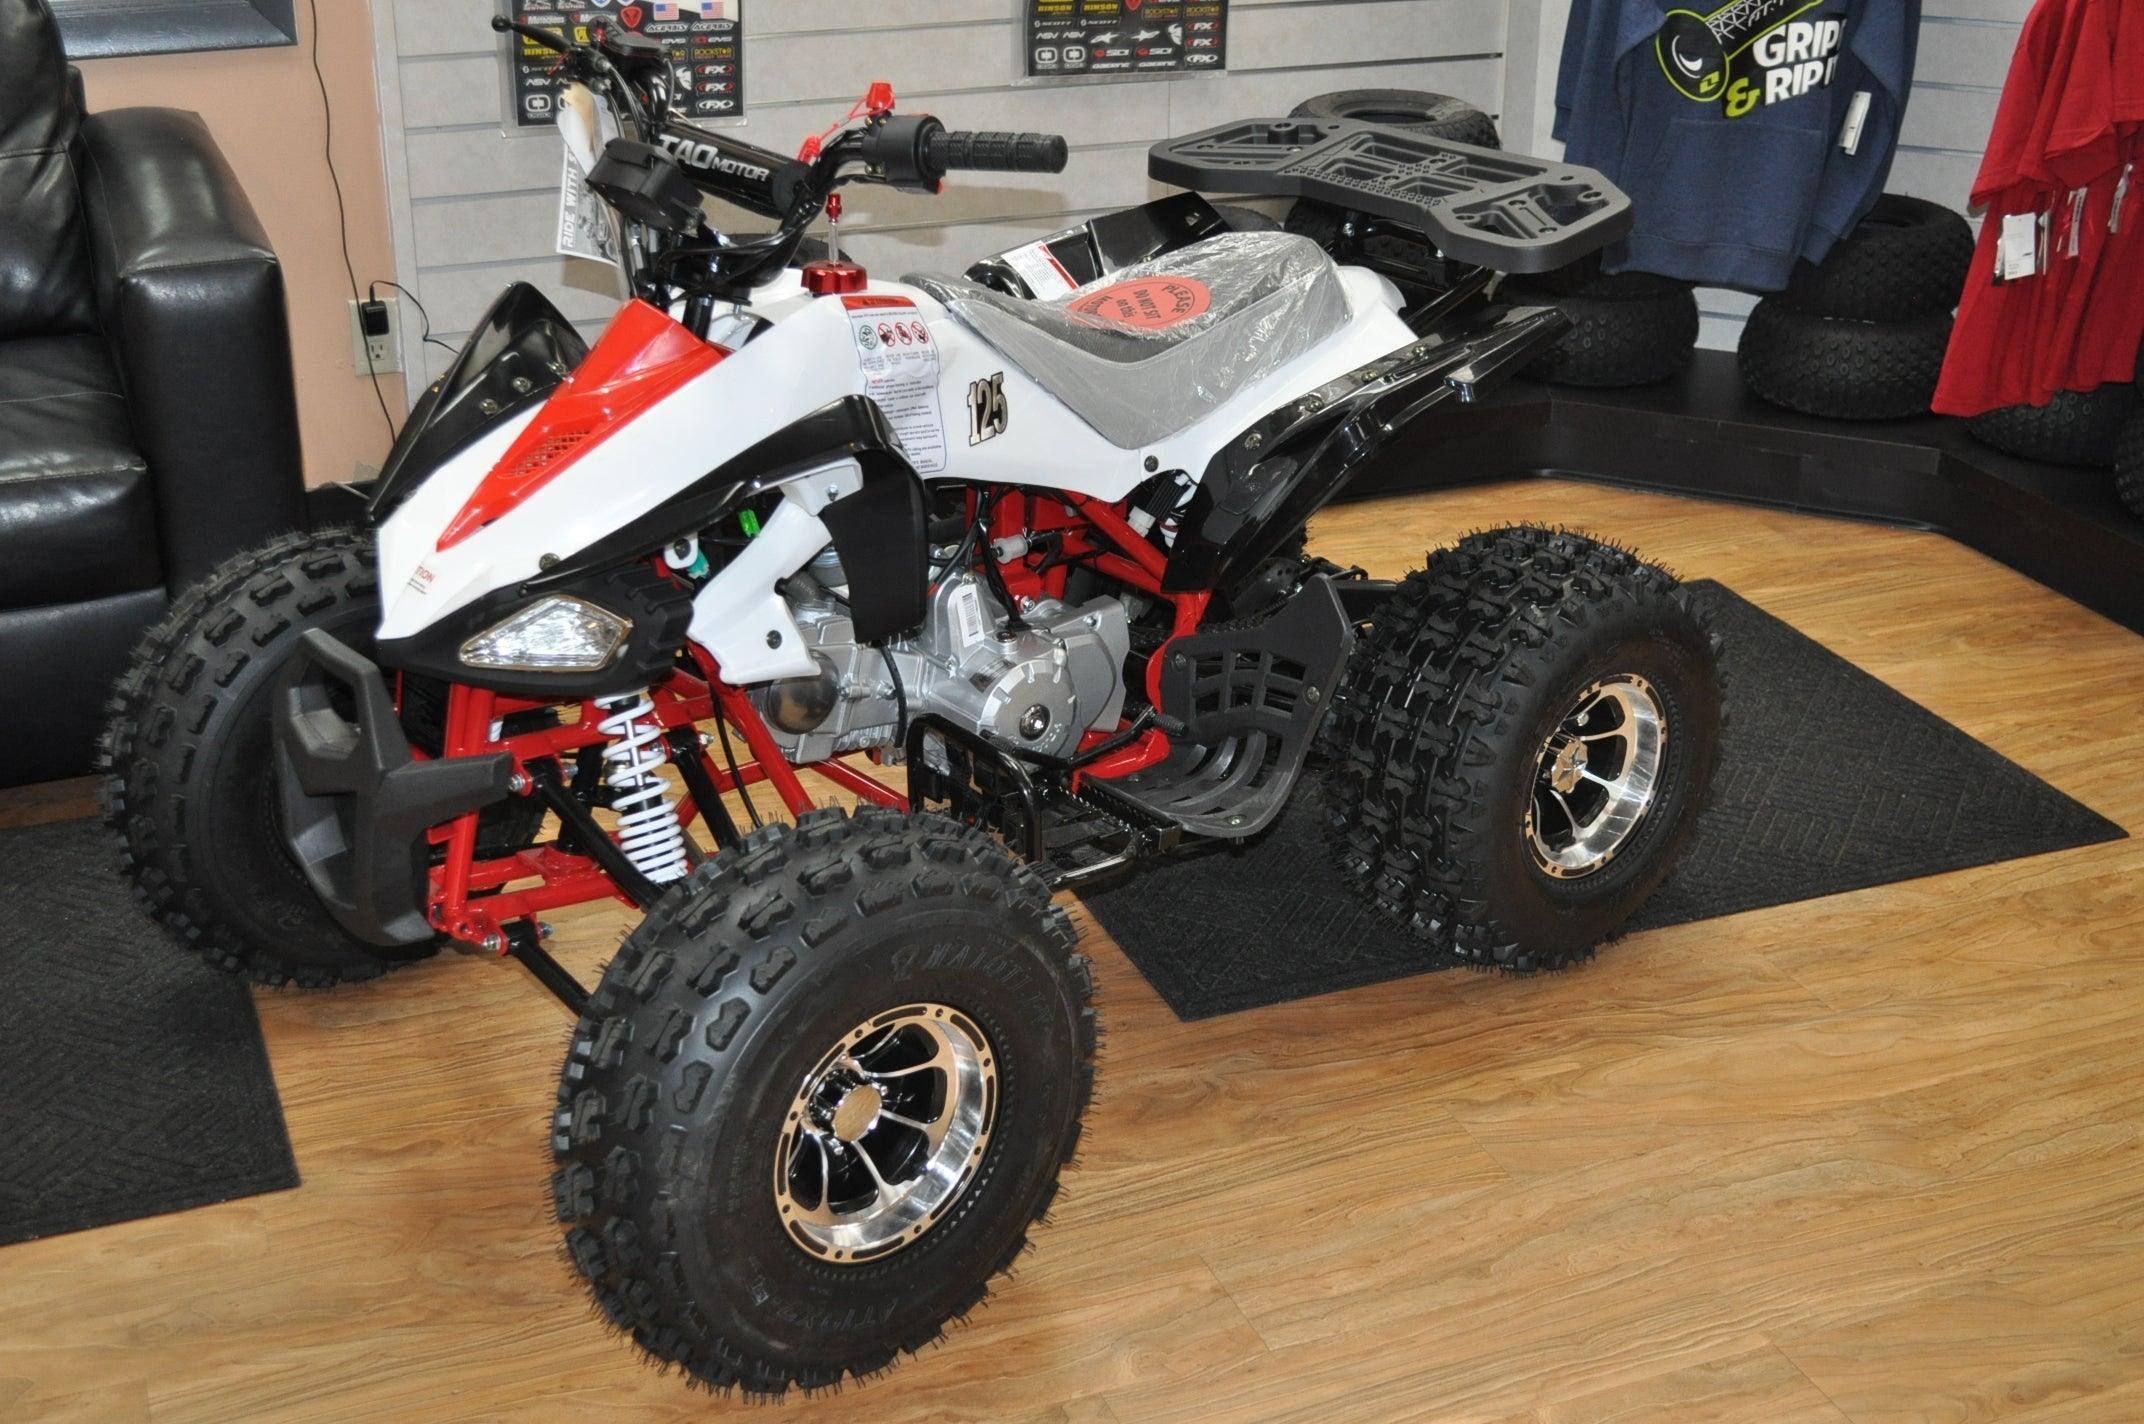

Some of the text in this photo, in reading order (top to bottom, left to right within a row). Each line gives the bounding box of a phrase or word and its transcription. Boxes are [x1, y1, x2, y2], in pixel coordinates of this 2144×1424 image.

[1752, 19, 1841, 68] GRIP
[1725, 77, 1761, 118] &
[1764, 60, 1825, 106] RIP
[658, 133, 771, 182] TAO MOTOR
[564, 167, 578, 207] WITH
[562, 210, 576, 249] RIDE
[1133, 288, 1162, 320] DO NOT SIT
[1162, 284, 1192, 314] PLEASE
[966, 371, 1009, 447] 125
